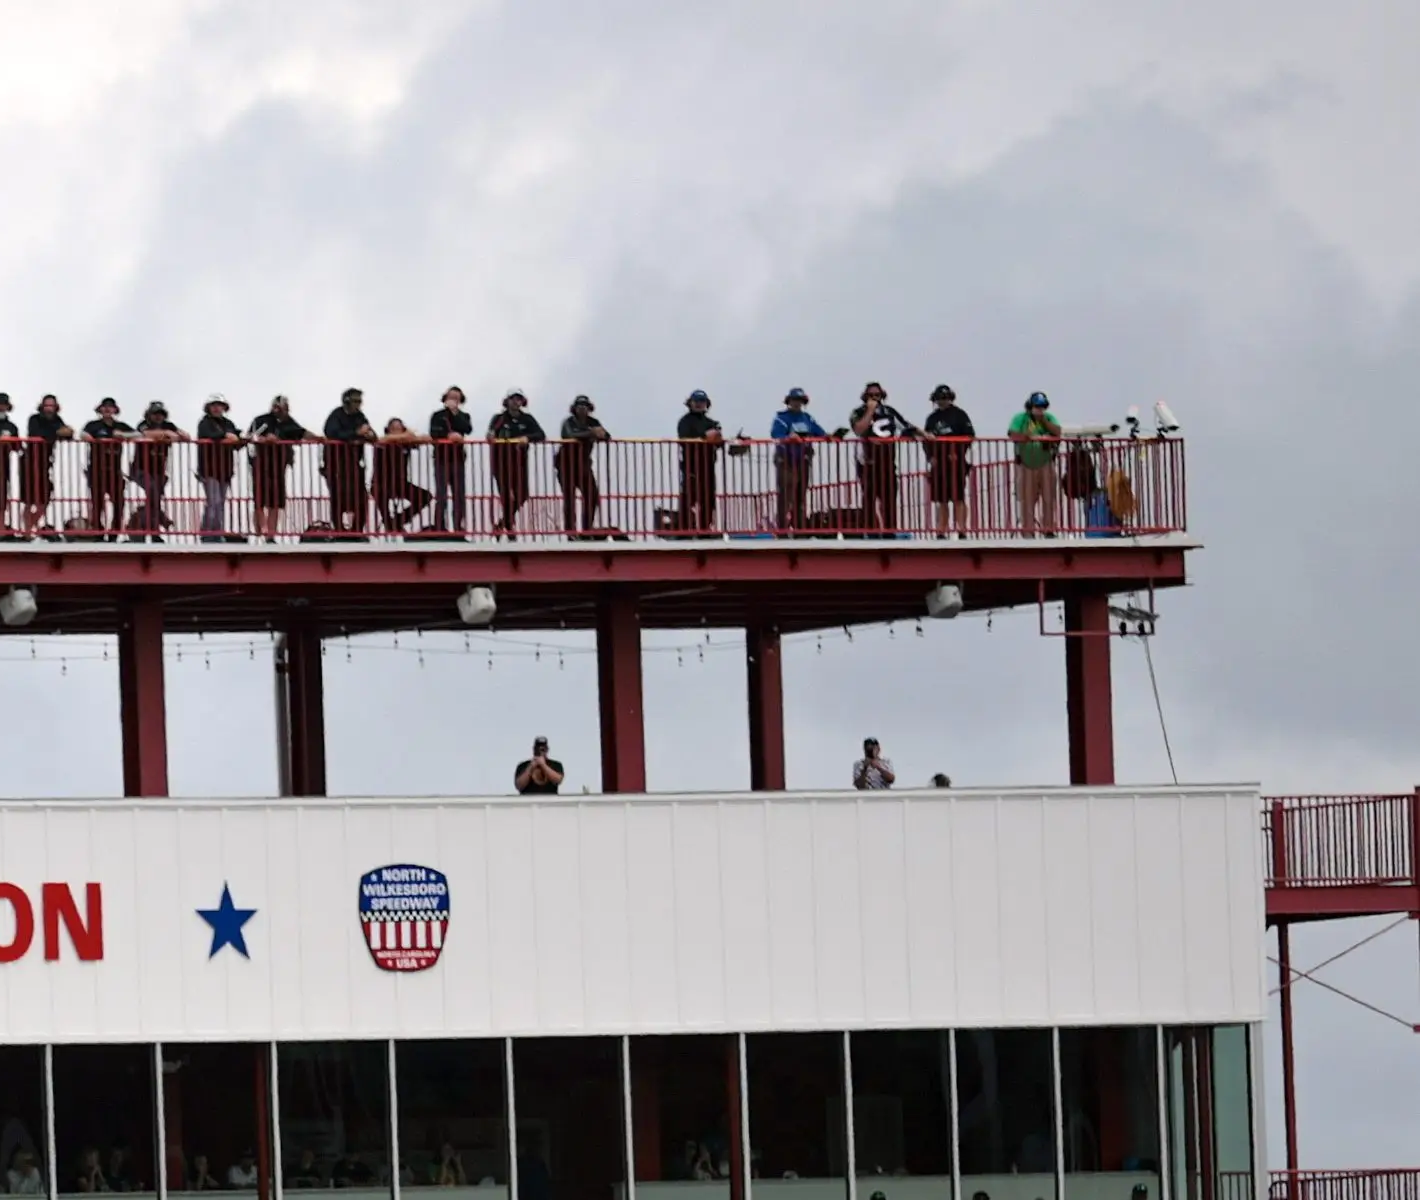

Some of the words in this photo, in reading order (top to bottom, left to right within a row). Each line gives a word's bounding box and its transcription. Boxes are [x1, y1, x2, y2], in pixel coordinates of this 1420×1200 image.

[381, 868, 427, 881] NORTH
[363, 883, 446, 896] WILKESBORO
[371, 897, 440, 910] SPEEDWAY
